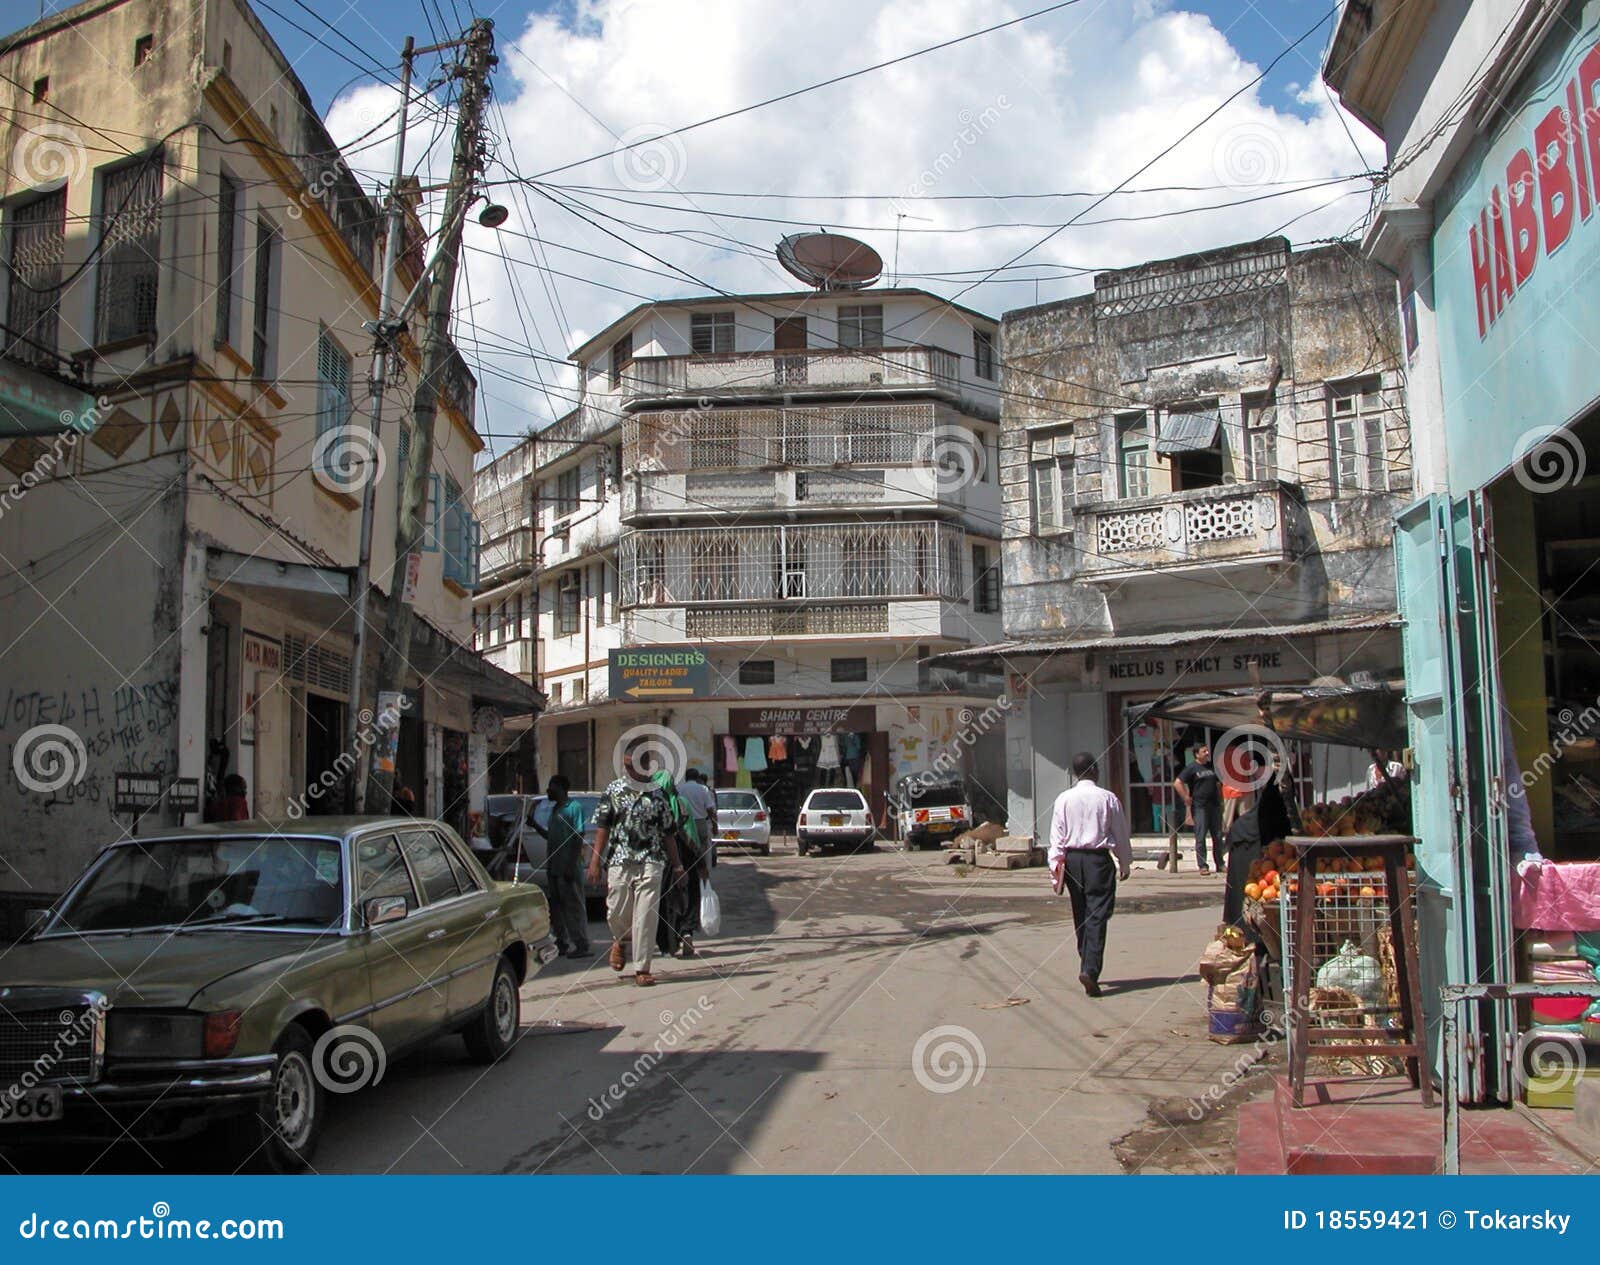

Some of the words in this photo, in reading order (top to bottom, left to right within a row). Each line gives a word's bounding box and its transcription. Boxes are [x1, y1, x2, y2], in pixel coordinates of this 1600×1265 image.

[623, 669, 658, 678] QUALITY
[1109, 661, 1165, 679] NEELUS
[1175, 657, 1221, 674] FANCY
[760, 711, 801, 721] SAHARA
[806, 709, 848, 720] CENTRE
